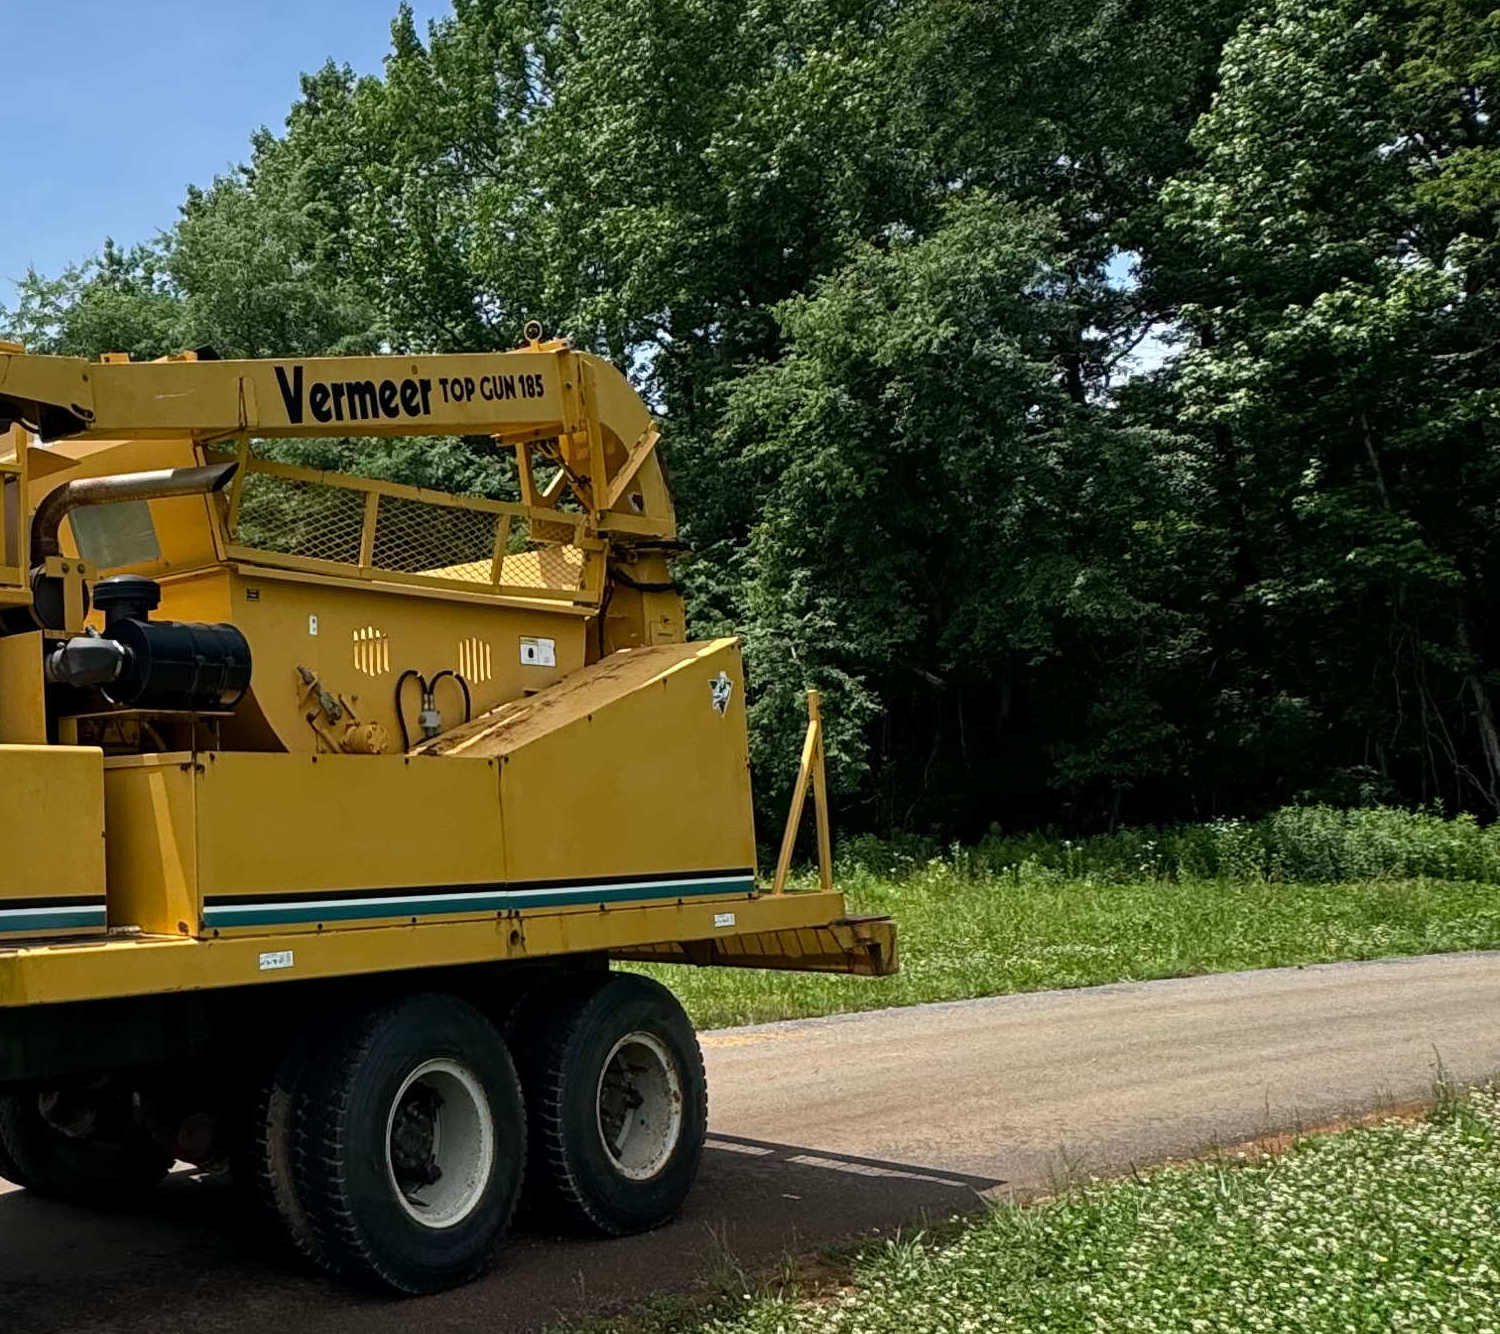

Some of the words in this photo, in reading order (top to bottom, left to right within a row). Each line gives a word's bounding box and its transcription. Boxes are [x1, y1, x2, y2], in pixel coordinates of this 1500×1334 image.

[274, 365, 432, 424] Vermeer
[438, 377, 476, 403] TOP
[480, 375, 517, 401] GUN
[518, 374, 544, 399] 185
